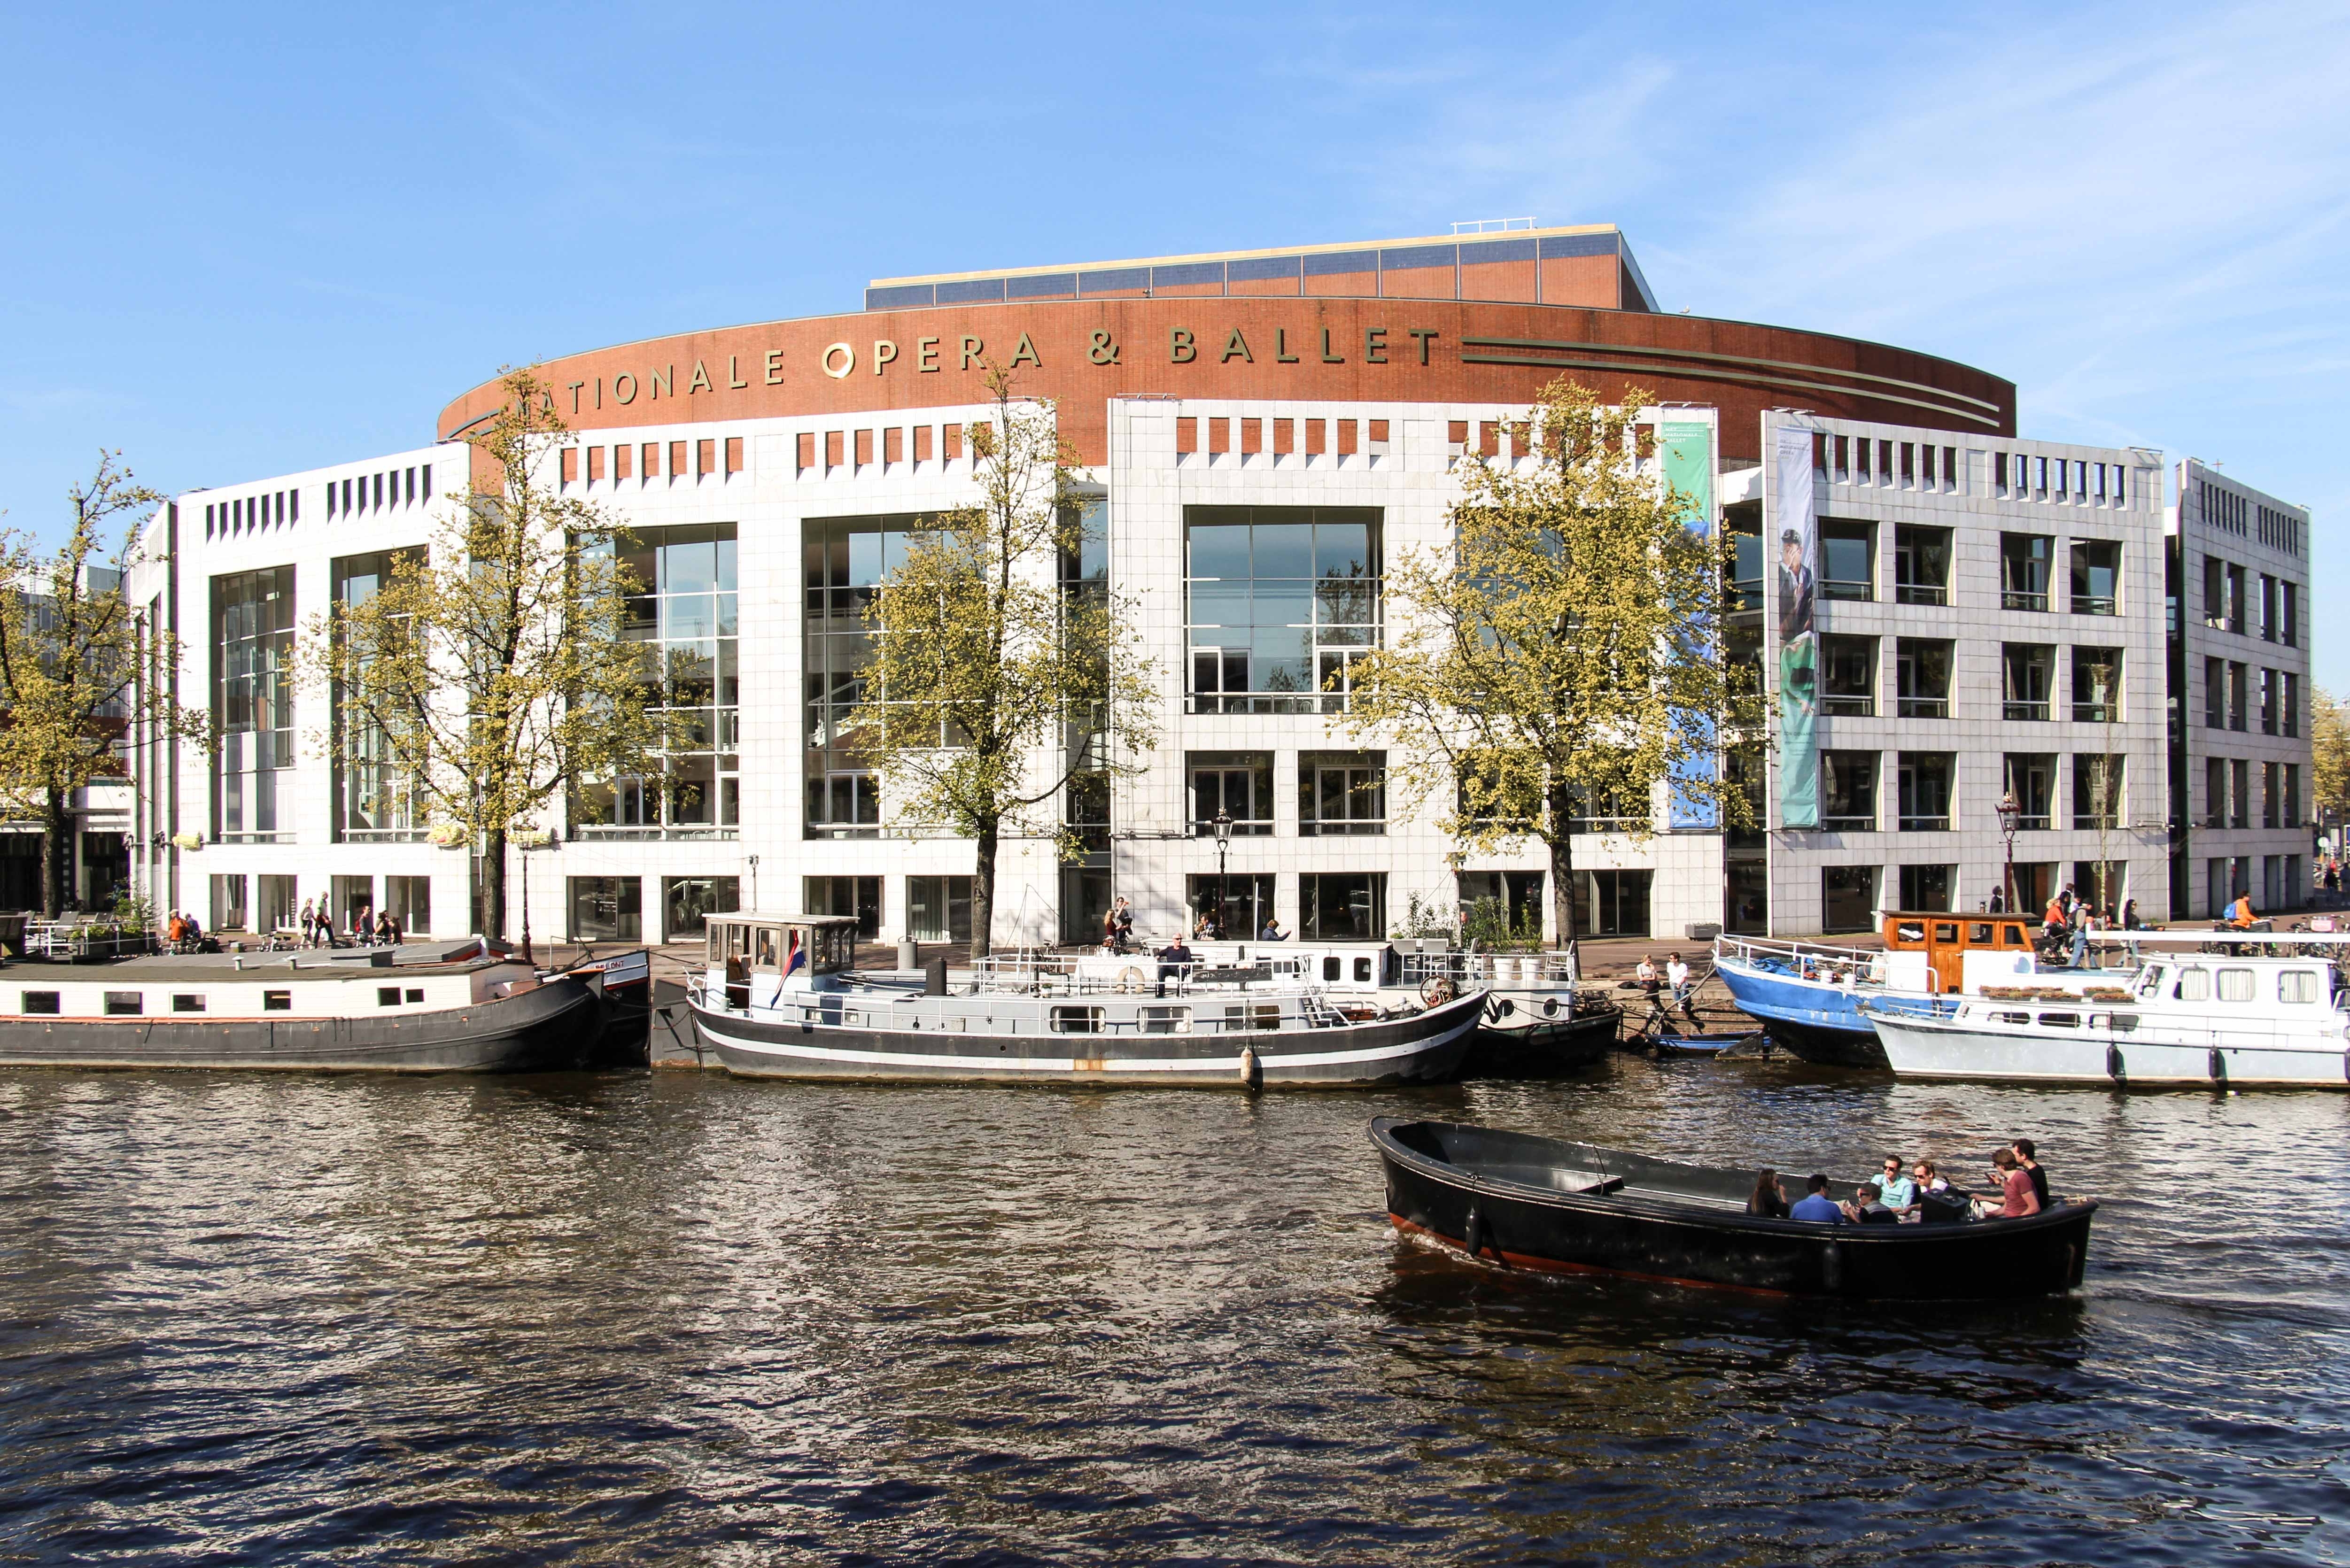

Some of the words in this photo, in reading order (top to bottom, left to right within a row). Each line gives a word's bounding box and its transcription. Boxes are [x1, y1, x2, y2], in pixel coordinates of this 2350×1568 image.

[515, 350, 783, 425] NATIONALE
[822, 332, 1042, 379] OPERA
[1087, 329, 1121, 365] &
[1170, 326, 1438, 365] BALLET
